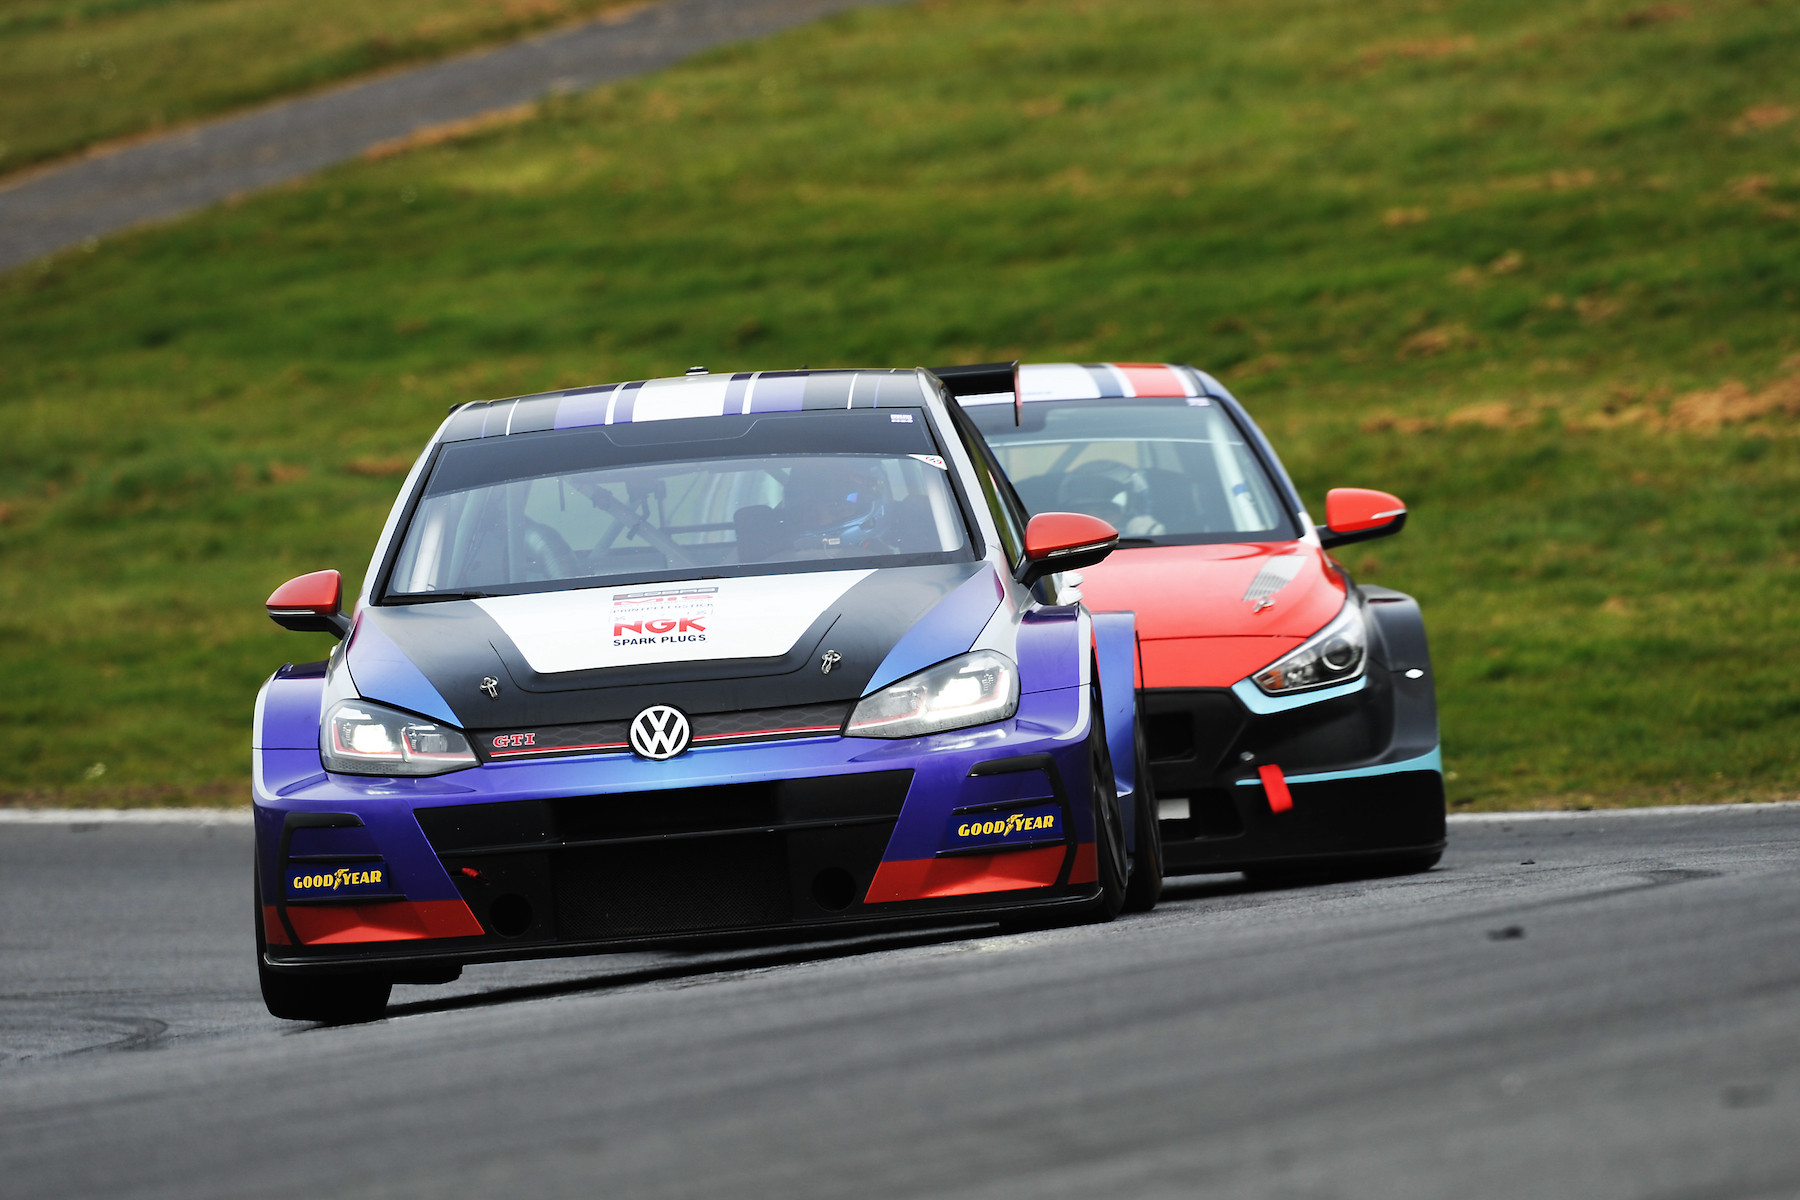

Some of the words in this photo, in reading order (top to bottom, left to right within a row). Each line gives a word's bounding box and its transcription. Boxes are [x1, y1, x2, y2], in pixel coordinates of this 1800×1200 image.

[613, 616, 706, 636] NGK
[613, 637, 656, 646] SPARK
[661, 634, 706, 643] PLUGS
[493, 733, 535, 747] GTI
[958, 814, 1055, 837] GOODYEAR
[293, 867, 383, 890] GOODYEAR
